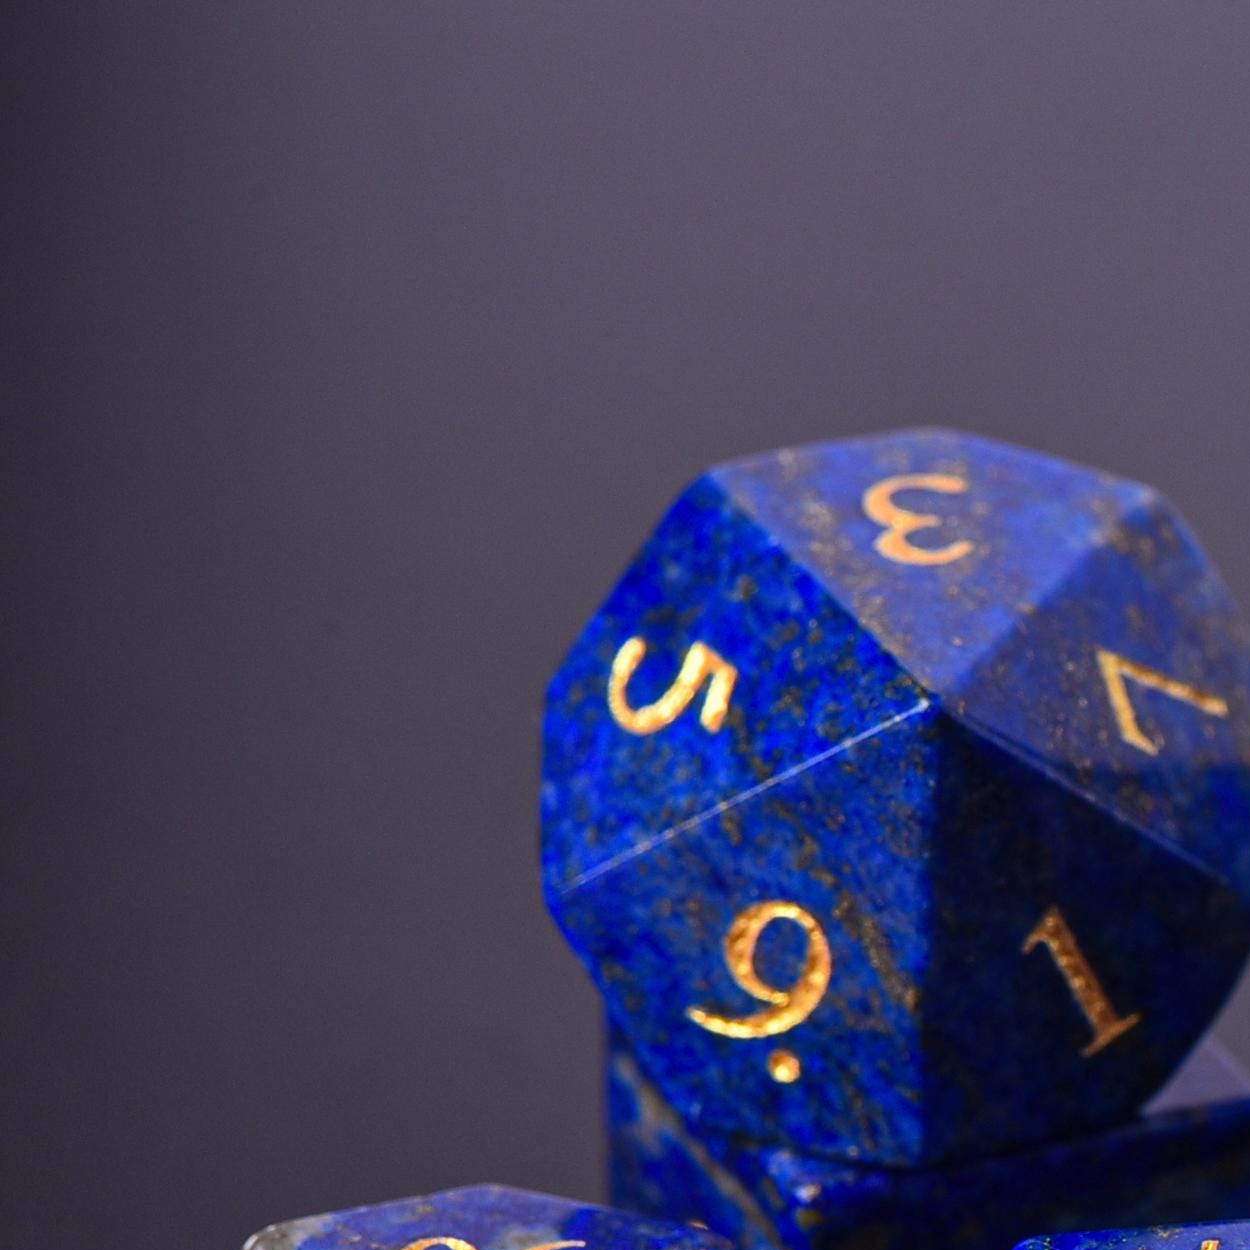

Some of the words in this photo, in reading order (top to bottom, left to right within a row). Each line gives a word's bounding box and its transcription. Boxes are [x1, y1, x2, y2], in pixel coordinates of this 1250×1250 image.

[862, 474, 975, 566] 3
[607, 636, 739, 735] 5
[1096, 648, 1229, 757] 7
[1020, 905, 1142, 1059] 1
